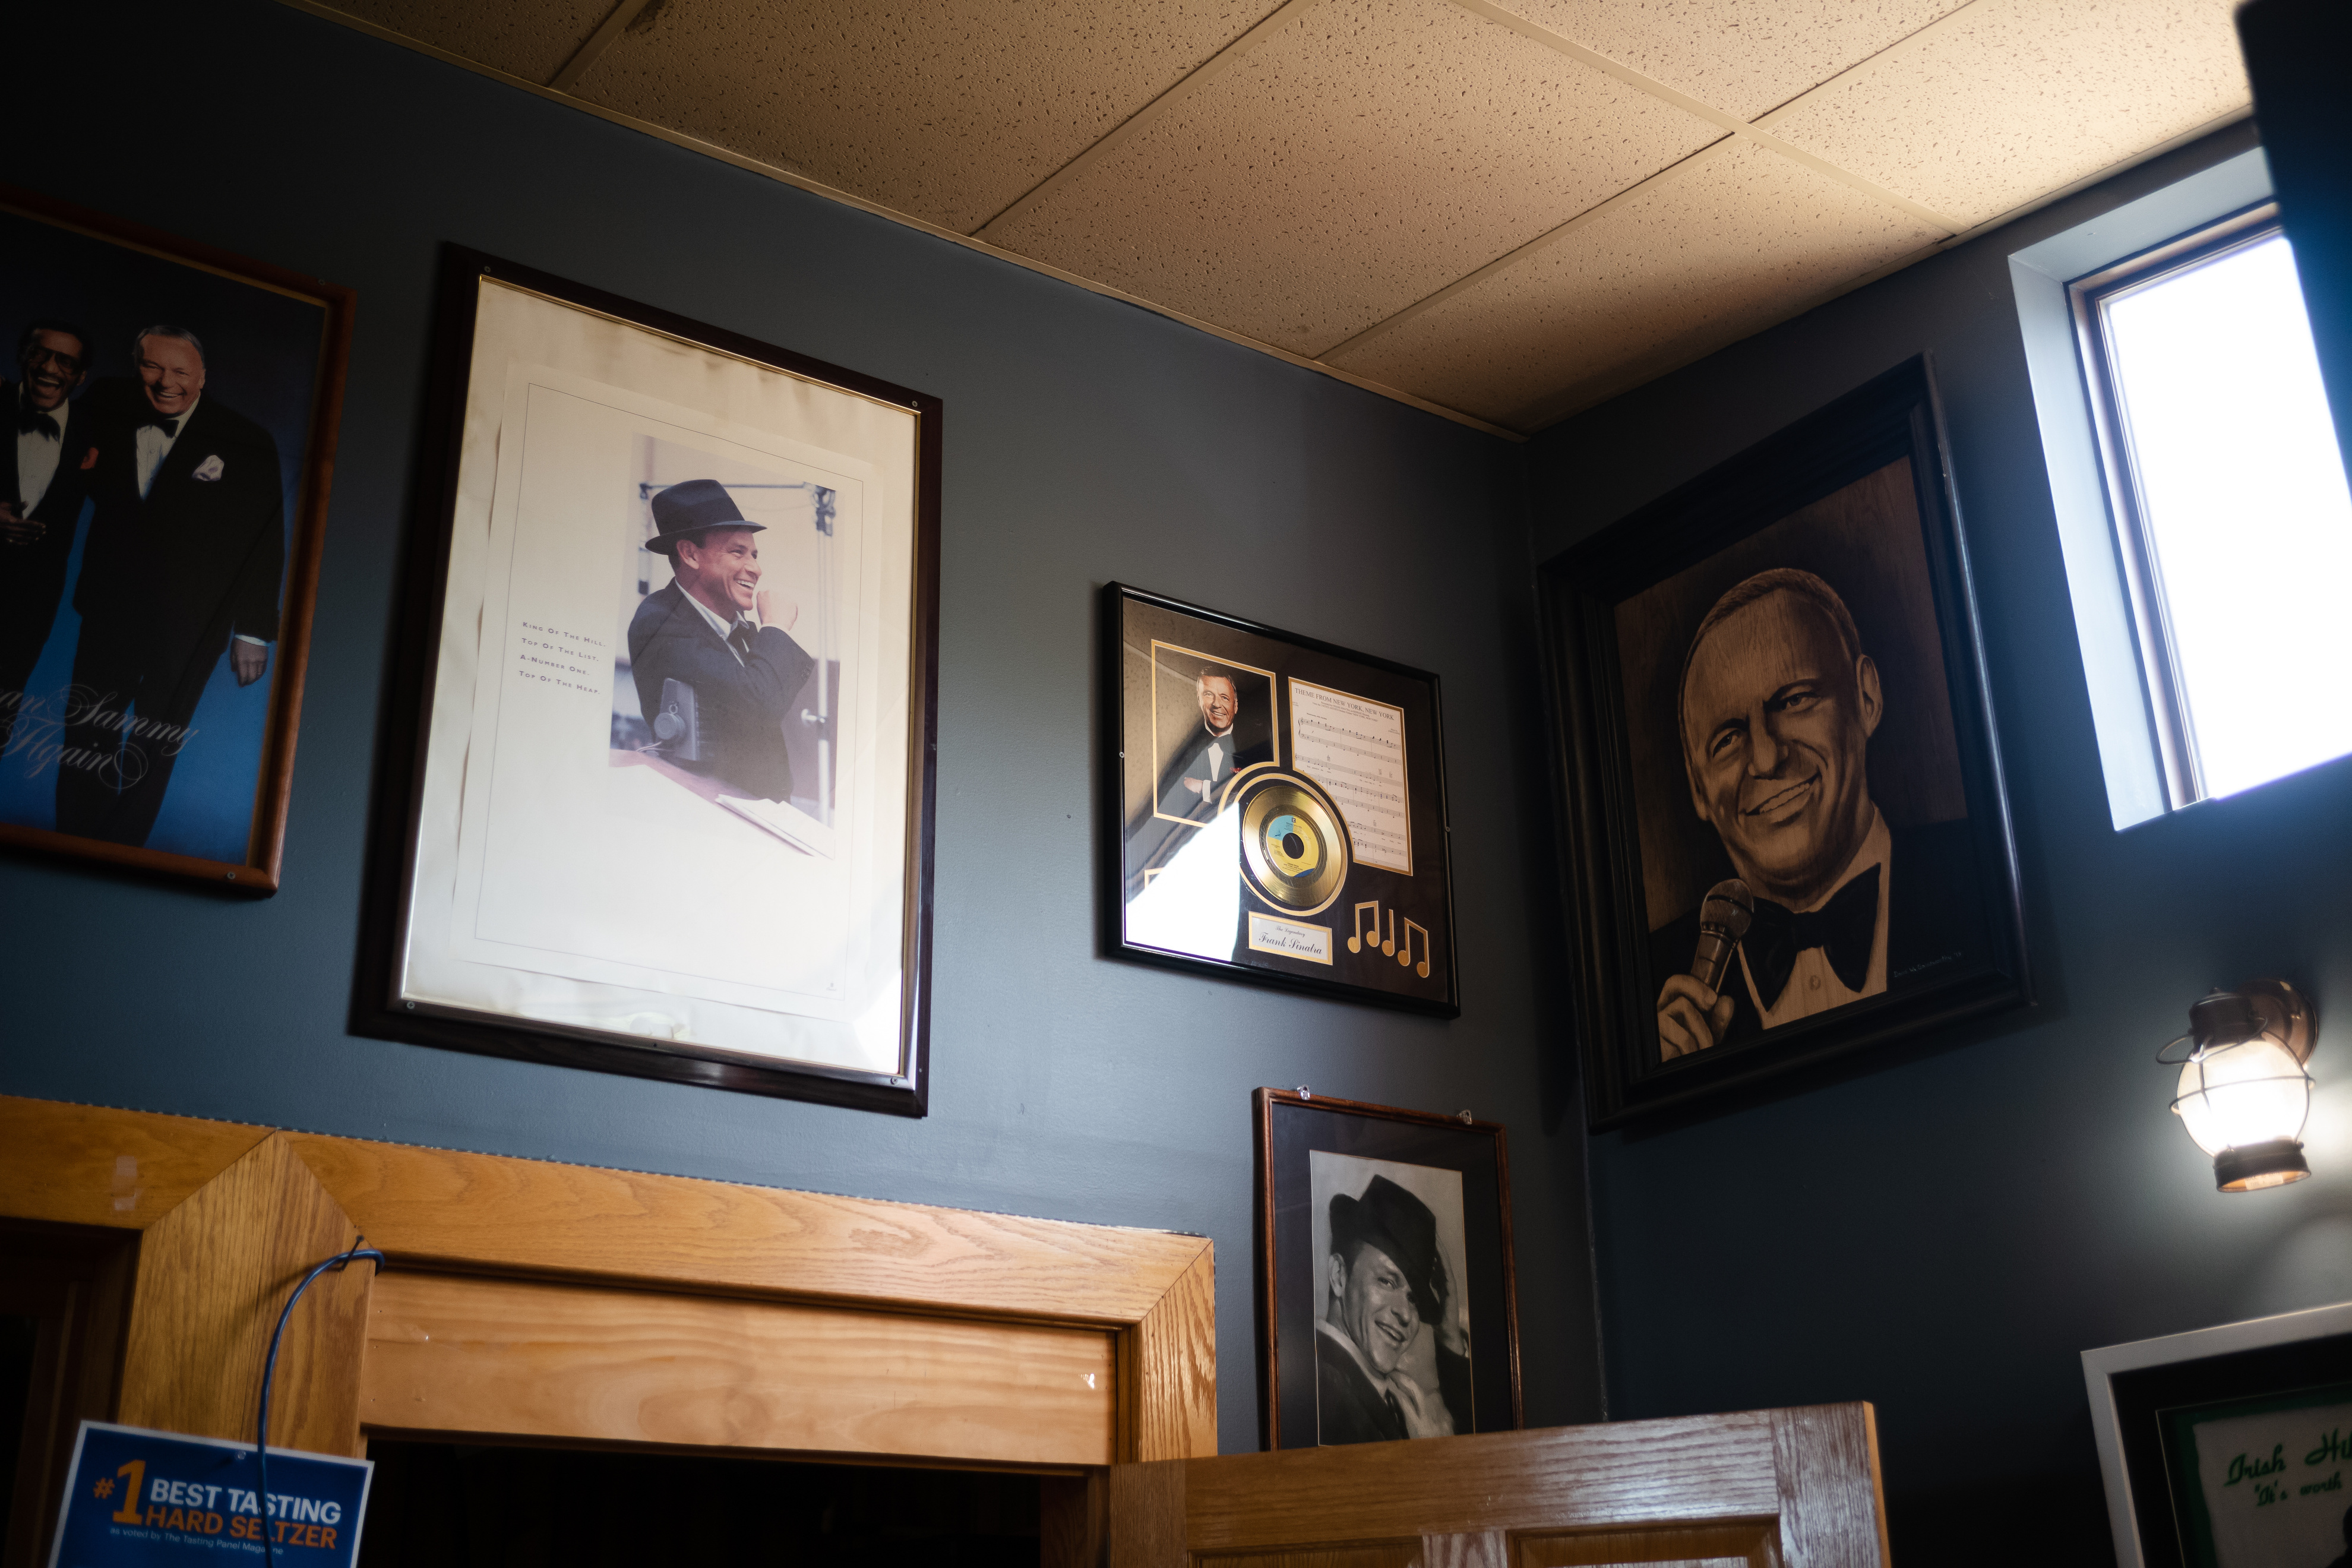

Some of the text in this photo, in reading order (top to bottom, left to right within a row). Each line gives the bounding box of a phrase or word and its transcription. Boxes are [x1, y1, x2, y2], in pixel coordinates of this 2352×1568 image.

[523, 622, 543, 631] KING
[564, 632, 579, 640] THE
[521, 638, 538, 646] TOP
[558, 647, 574, 655] THE
[519, 671, 535, 679] TOP
[556, 679, 572, 688] THE
[1295, 688, 1395, 720] THEME FROM NEW YORK, NEW YORK
[47, 684, 200, 757] Sammy
[2, 713, 148, 789] Again
[1259, 932, 1322, 954] Frank Sinatra
[1285, 927, 1305, 937] Legendary
[2224, 1443, 2287, 1487] Irish
[93, 1459, 147, 1525] #1
[150, 1478, 222, 1509] BEST
[2300, 1471, 2342, 1496] worth
[123, 1529, 148, 1538] voted
[150, 1531, 162, 1540] by
[165, 1533, 181, 1542] The
[184, 1535, 214, 1548] Tasting
[216, 1539, 240, 1550] Panel
[146, 1504, 337, 1550] HARD SETZER
